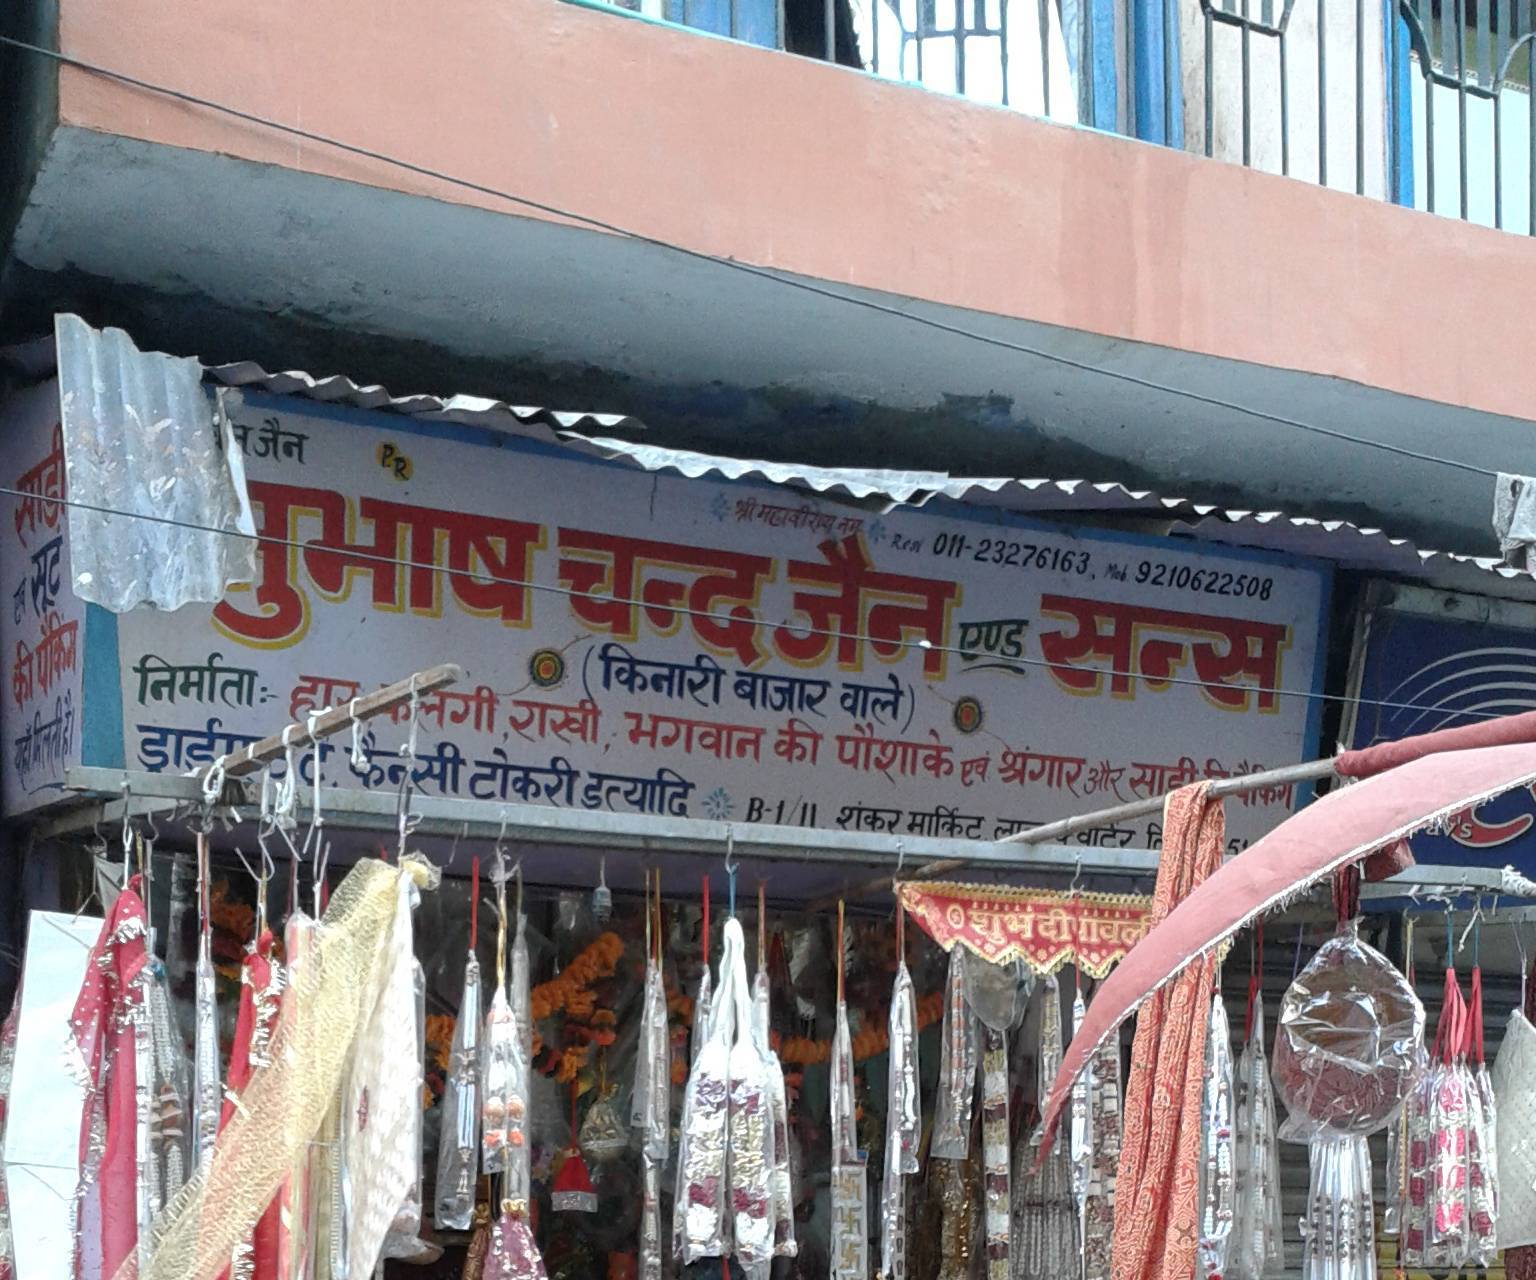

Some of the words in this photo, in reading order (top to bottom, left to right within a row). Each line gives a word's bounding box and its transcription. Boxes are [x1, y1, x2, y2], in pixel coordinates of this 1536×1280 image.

[254, 416, 310, 465] जैन
[1134, 560, 1275, 602] 9210622508
[555, 526, 776, 672] चन्द
[772, 530, 963, 682] जैन
[1039, 592, 1293, 716] सन्स
[733, 670, 832, 718] बाजार
[623, 710, 766, 763] भगवान
[773, 717, 823, 766] की
[468, 747, 581, 807] टोकरी
[967, 907, 1035, 945] शुभ
